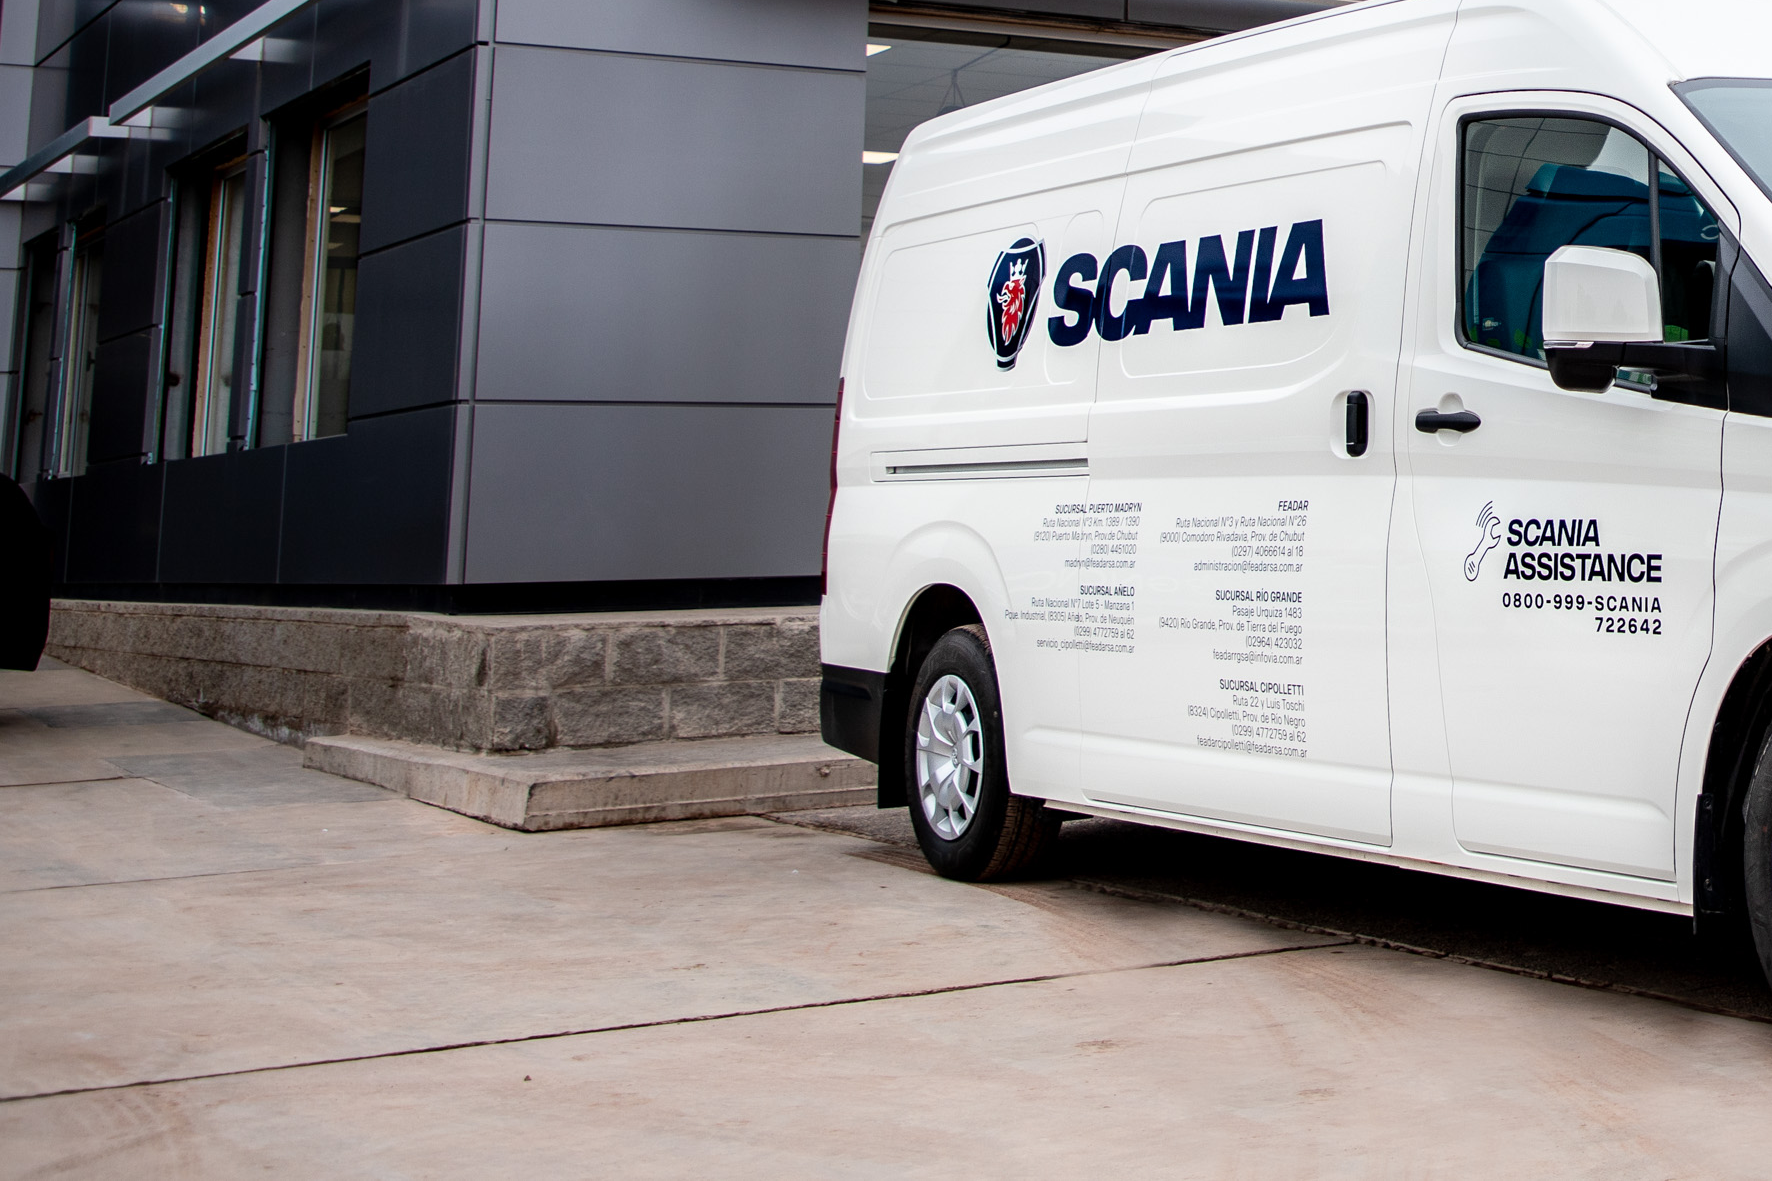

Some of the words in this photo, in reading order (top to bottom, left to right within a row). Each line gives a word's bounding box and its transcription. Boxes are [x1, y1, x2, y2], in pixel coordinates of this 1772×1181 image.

[1048, 219, 1330, 347] SCANIA
[1056, 504, 1086, 514] SUCURSAL
[1089, 503, 1113, 513] PUERTO
[1114, 503, 1142, 512] MADRYN
[1278, 500, 1308, 511] FEADAR
[1057, 518, 1080, 527] Nacional
[1176, 518, 1190, 528] Ruta
[1192, 517, 1219, 528] Nacional
[1240, 516, 1255, 527] Ruta
[1257, 516, 1287, 527] Nacional
[1052, 531, 1070, 541] Puerto
[1117, 530, 1138, 540] Chubut
[1160, 532, 1180, 543] (9000)
[1182, 531, 1215, 542] Comodoro
[1216, 531, 1249, 543] Rivadavia,
[1251, 531, 1267, 542] Prov.
[1269, 531, 1277, 542] de
[1279, 530, 1305, 542] Chubut
[1507, 519, 1600, 546] SCANIA
[1232, 546, 1253, 557] (0297)
[1255, 545, 1285, 556] 4066614
[1287, 546, 1293, 556] al
[1295, 546, 1303, 556] 18
[1194, 560, 1303, 573] administracion@feadarsa.com.ar
[1503, 552, 1662, 583] ASSISTANCE
[1080, 585, 1112, 596] SUCURSAL
[1114, 584, 1135, 596] AÑELO
[1216, 590, 1254, 601] SUCURSAL
[1256, 588, 1269, 602] RÍO
[1271, 591, 1302, 603] GRANDE
[1032, 597, 1044, 607] Ruta
[1046, 598, 1069, 607] Nacional
[1082, 600, 1094, 609] Lote
[1105, 601, 1130, 610] Manzana
[1502, 592, 1662, 613] 0800-999-SCANIA
[1100, 614, 1107, 623] de
[1233, 605, 1254, 618] Pasaje
[1256, 607, 1283, 619] Urquiza
[1285, 607, 1302, 618] 1483
[1159, 617, 1179, 629] (9420)
[1192, 619, 1217, 631] Grande,
[1219, 619, 1235, 630] Prov.
[1236, 620, 1244, 631] de
[1247, 621, 1266, 632] Tierra
[1268, 622, 1278, 632] del
[1280, 622, 1302, 636] Fuego
[1595, 617, 1662, 635] 722642
[1127, 629, 1134, 639] 62
[1246, 636, 1272, 648] (02964)
[1274, 638, 1302, 649] 423032
[1213, 649, 1302, 665] feadarrgsa@infovia.com.ar
[1220, 679, 1258, 692] SUCURSAL
[1261, 682, 1304, 695] CIPOLLETTI
[1233, 695, 1248, 706] Ruta
[1250, 696, 1259, 707] 22
[1261, 699, 1265, 710] y
[1267, 698, 1280, 709] Luis
[1282, 699, 1304, 711] Toschi
[1210, 708, 1241, 722] Cipolletti,
[1243, 711, 1259, 722] Prov.
[1261, 712, 1269, 723] de
[1284, 714, 1305, 729] Negro
[1232, 724, 1254, 737] (0299)
[1256, 727, 1287, 740] 4772759
[1289, 730, 1295, 741] al
[1297, 731, 1306, 742] 62
